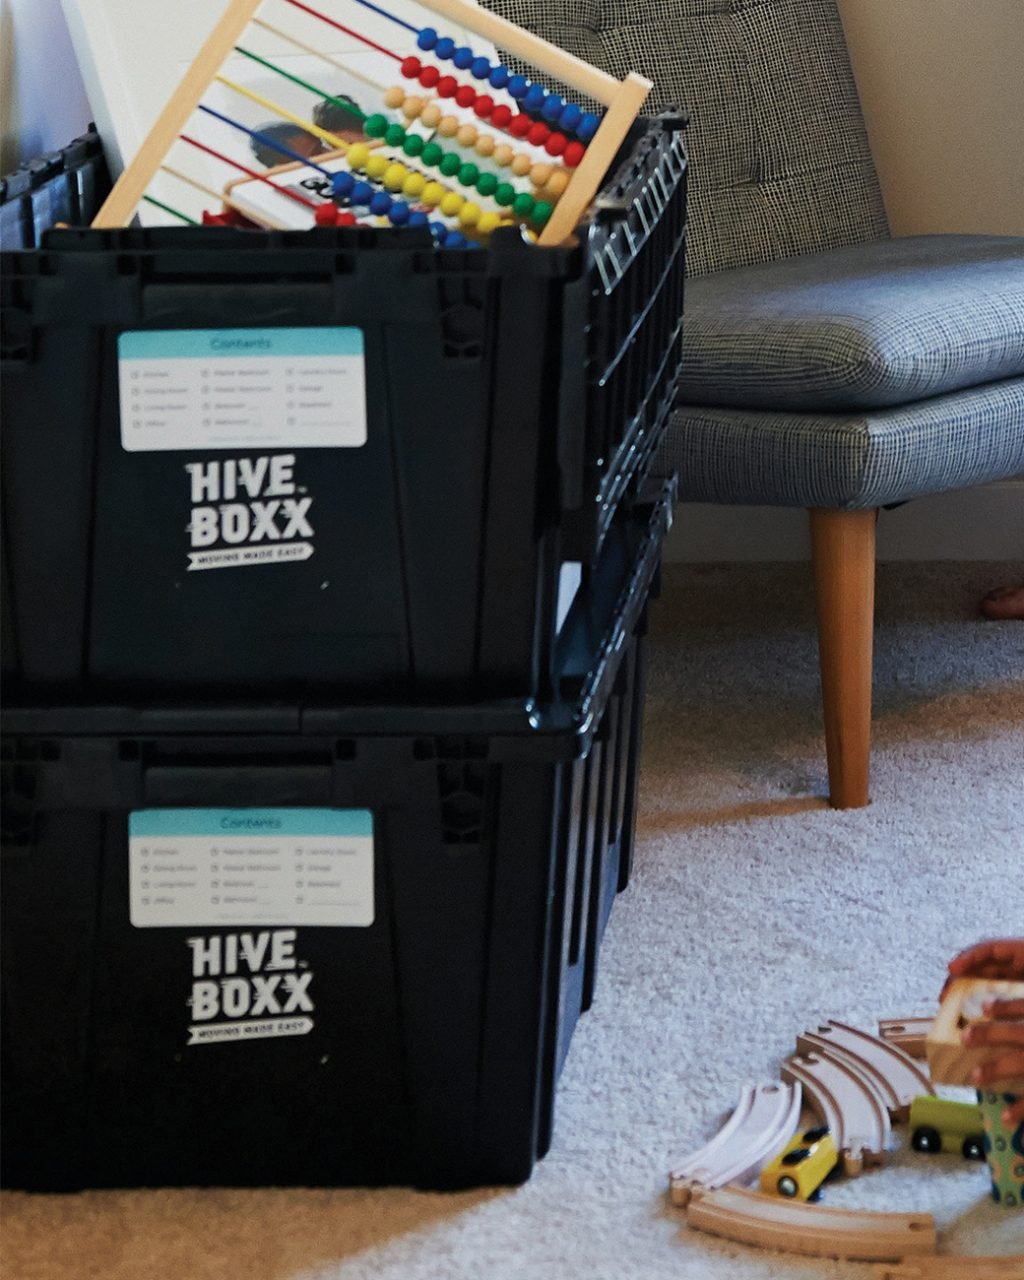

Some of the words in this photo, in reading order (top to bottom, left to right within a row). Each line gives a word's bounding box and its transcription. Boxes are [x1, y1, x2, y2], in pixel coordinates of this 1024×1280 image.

[209, 336, 272, 351] Contents
[186, 453, 296, 503] HIVE
[186, 497, 315, 547] BOXX
[220, 816, 281, 830] Contents
[187, 929, 297, 977] HIVE
[186, 972, 315, 1021] BOXX
